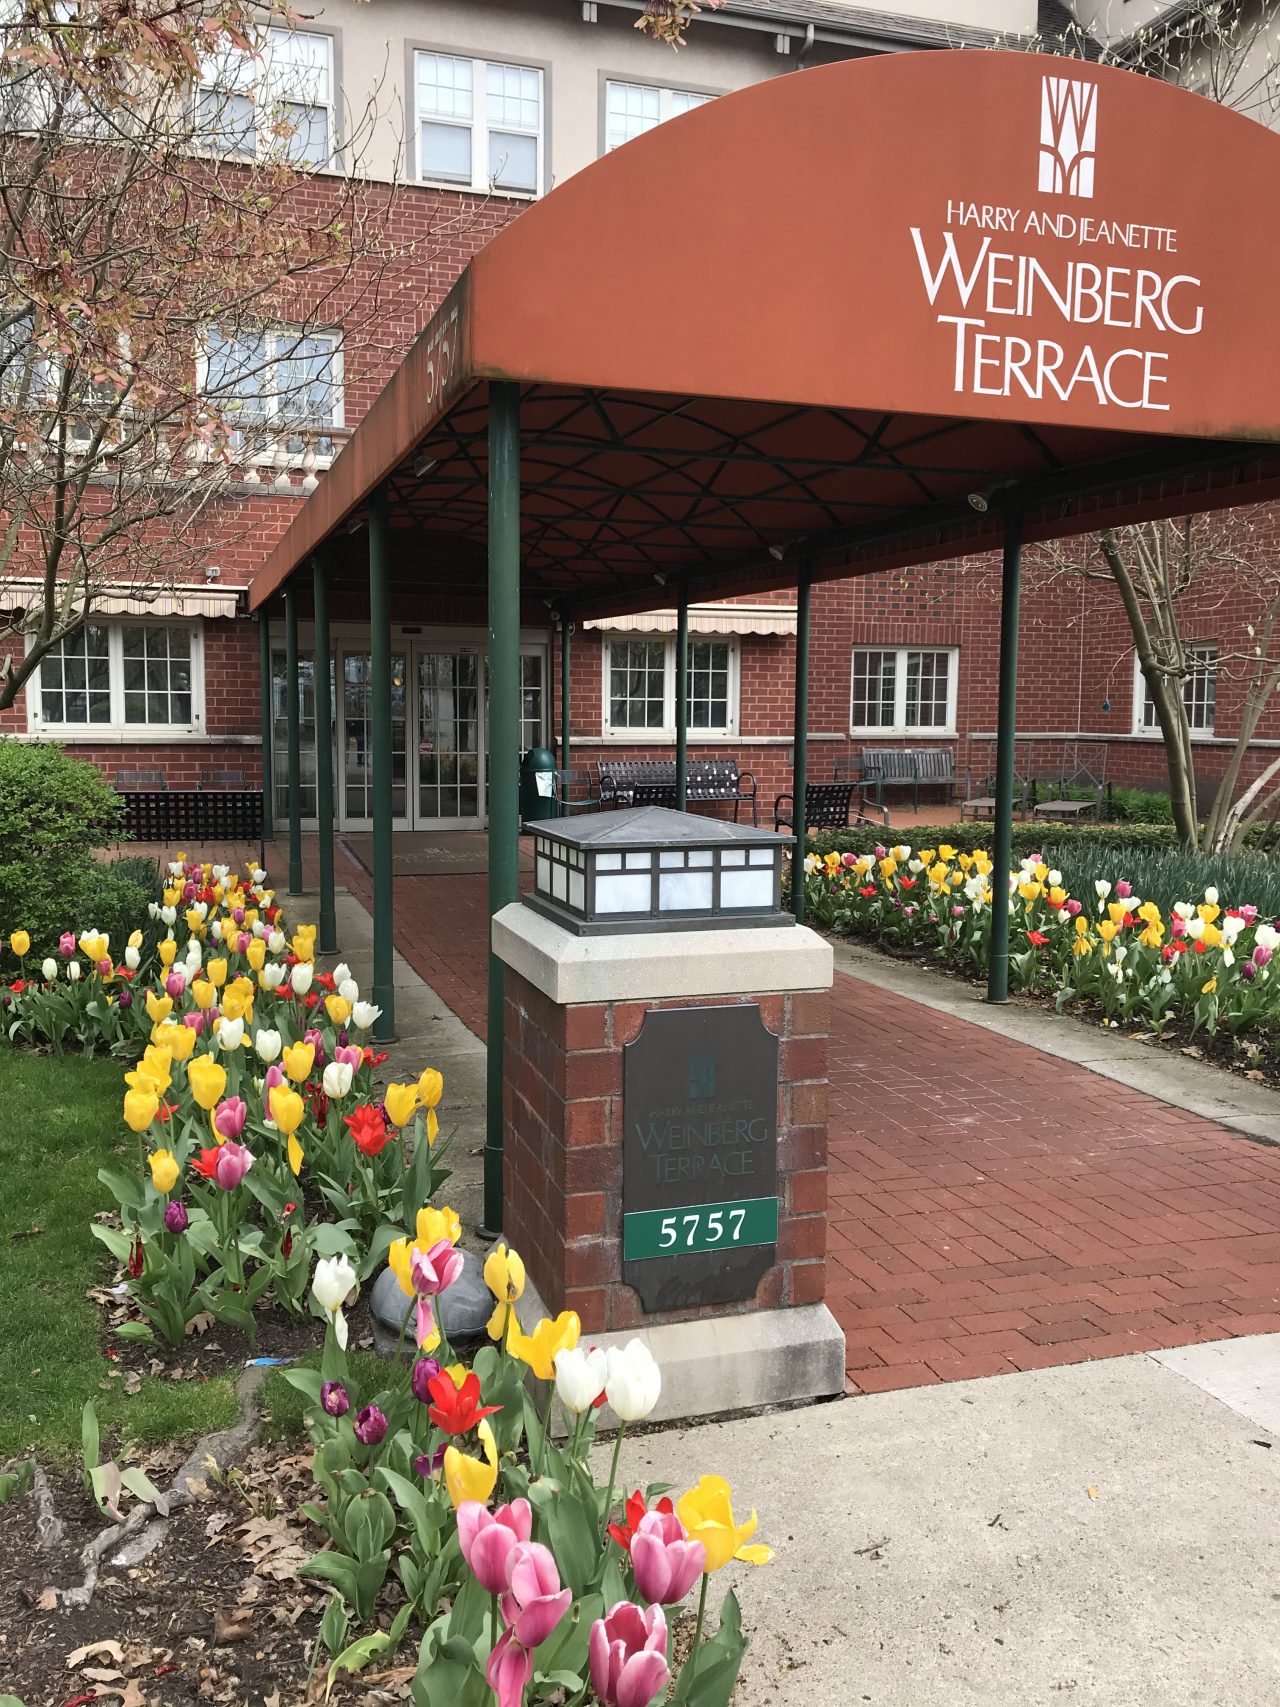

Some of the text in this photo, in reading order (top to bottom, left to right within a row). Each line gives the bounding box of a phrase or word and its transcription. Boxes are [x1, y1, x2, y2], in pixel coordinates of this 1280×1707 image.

[946, 199, 1178, 253] HARRY AND JEANETTE
[909, 226, 1204, 335] WEINBERG
[427, 304, 459, 404] 5757
[936, 314, 1170, 411] TERRACE
[636, 1118, 768, 1152] WEINBERG
[649, 1151, 755, 1184] TERRACE
[658, 1208, 746, 1249] 5757
